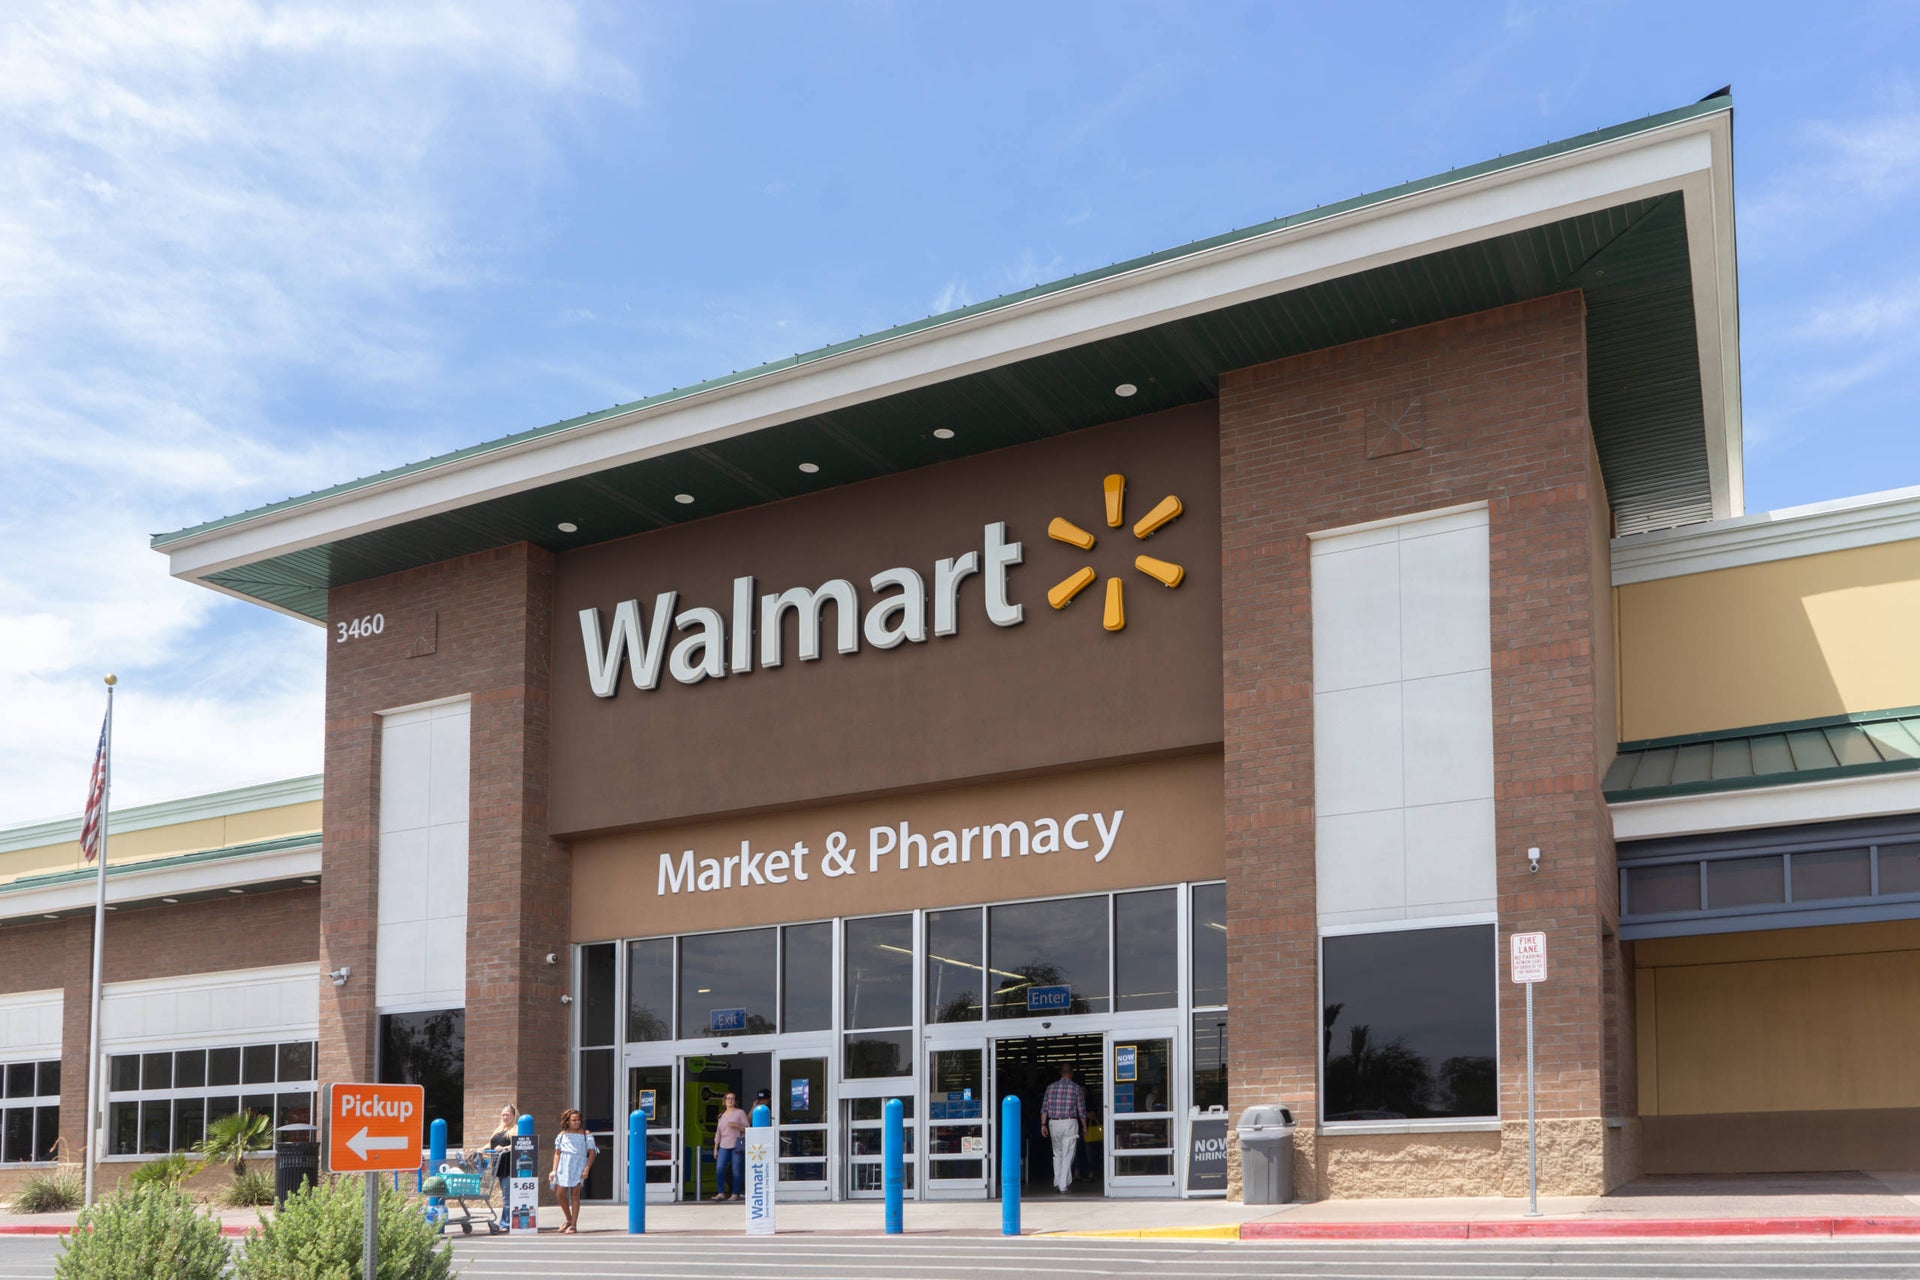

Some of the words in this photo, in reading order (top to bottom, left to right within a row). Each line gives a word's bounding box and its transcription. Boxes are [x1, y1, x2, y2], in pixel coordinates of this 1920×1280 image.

[579, 521, 1024, 698] Walmart
[336, 613, 385, 643] 3460
[657, 840, 809, 896] Market
[820, 831, 857, 878] &
[868, 809, 1125, 872] Pharmacy
[1519, 936, 1537, 944] FIRE
[1518, 945, 1539, 954] LANE
[1032, 991, 1066, 1005] Enter
[718, 1013, 738, 1026] Exit
[1117, 1053, 1134, 1062] NOW
[341, 1094, 413, 1123] Pickup
[513, 1182, 535, 1191] $.68
[752, 1163, 763, 1219] Walmart
